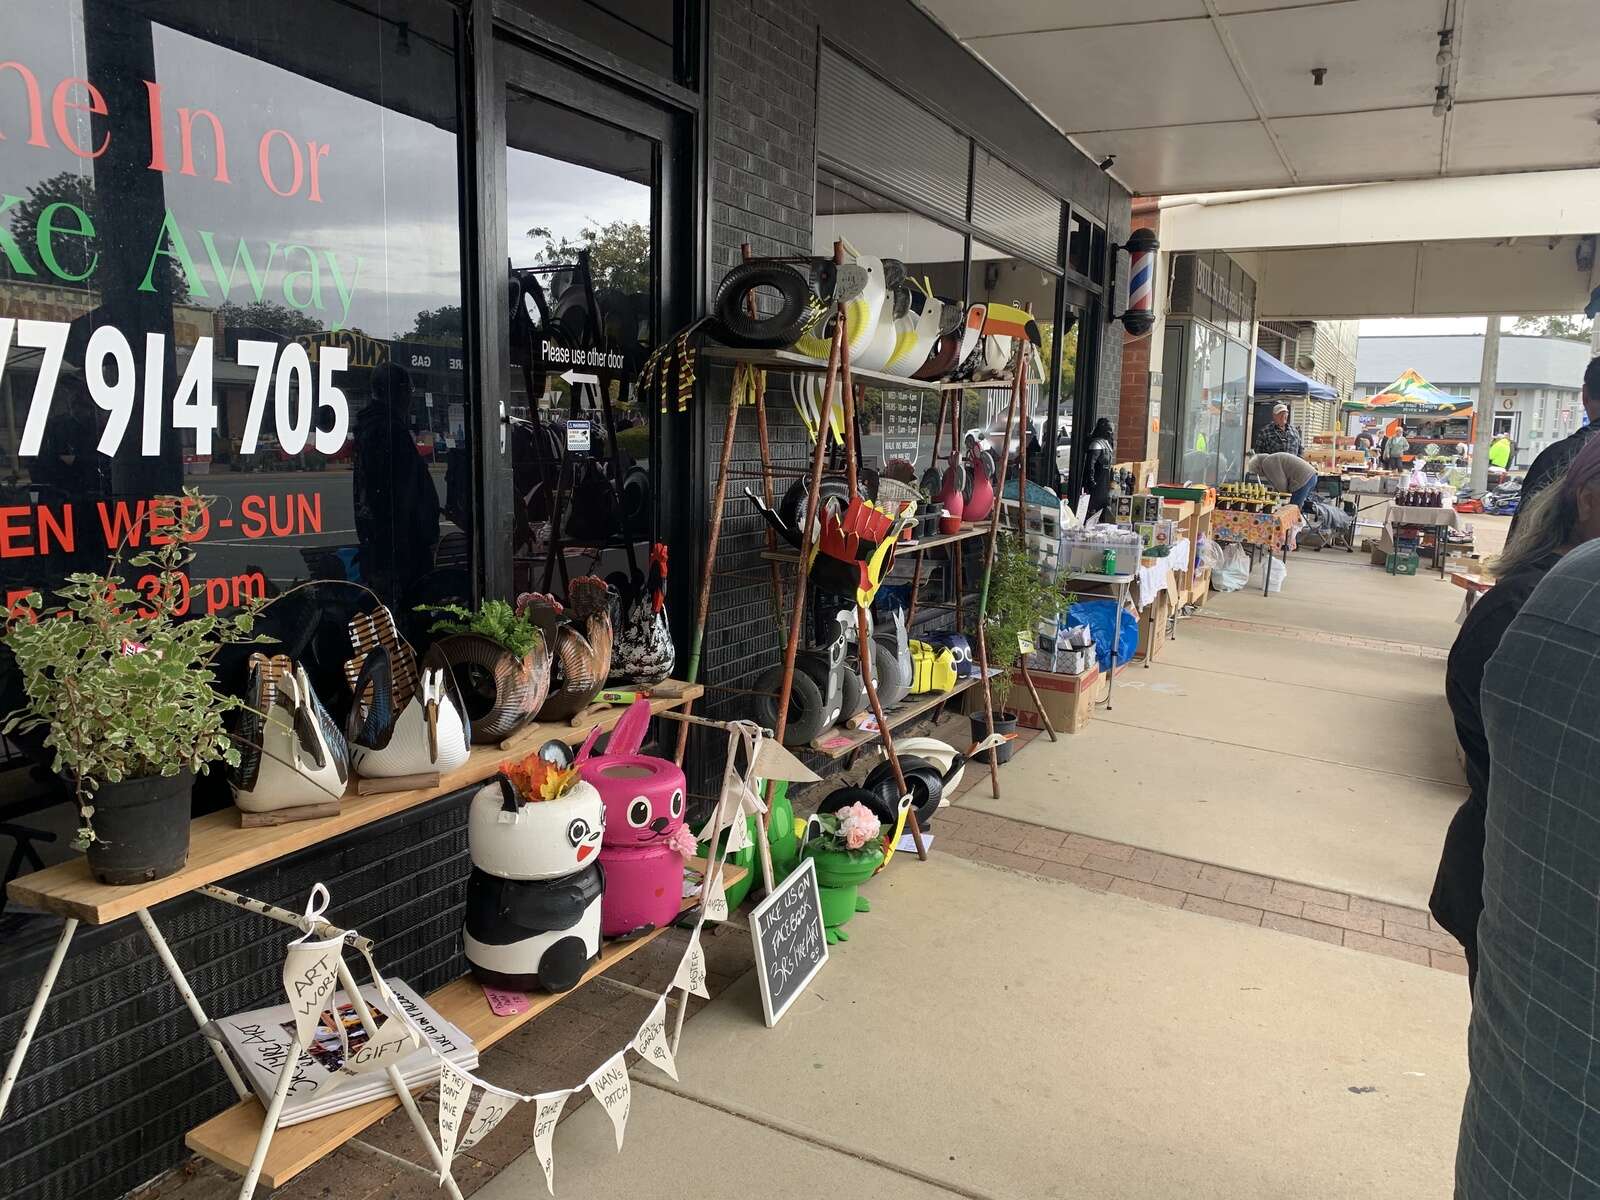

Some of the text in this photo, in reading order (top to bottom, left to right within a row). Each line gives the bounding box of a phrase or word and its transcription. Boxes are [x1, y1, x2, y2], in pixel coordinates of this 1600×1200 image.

[142, 80, 232, 185] In
[258, 128, 331, 204] or
[137, 208, 364, 332] Away
[542, 340, 624, 369] Please use other door
[0, 317, 349, 458] 7 914 705
[206, 571, 266, 616] pm
[771, 896, 812, 957] FACEBOOK
[294, 953, 331, 998] ART
[298, 962, 339, 1016] WORK
[689, 950, 699, 992] EASTER
[228, 1021, 277, 1045] ART
[355, 1034, 410, 1064] GIFT
[603, 1083, 629, 1109] PATCH
[534, 1119, 555, 1138] GIFT
